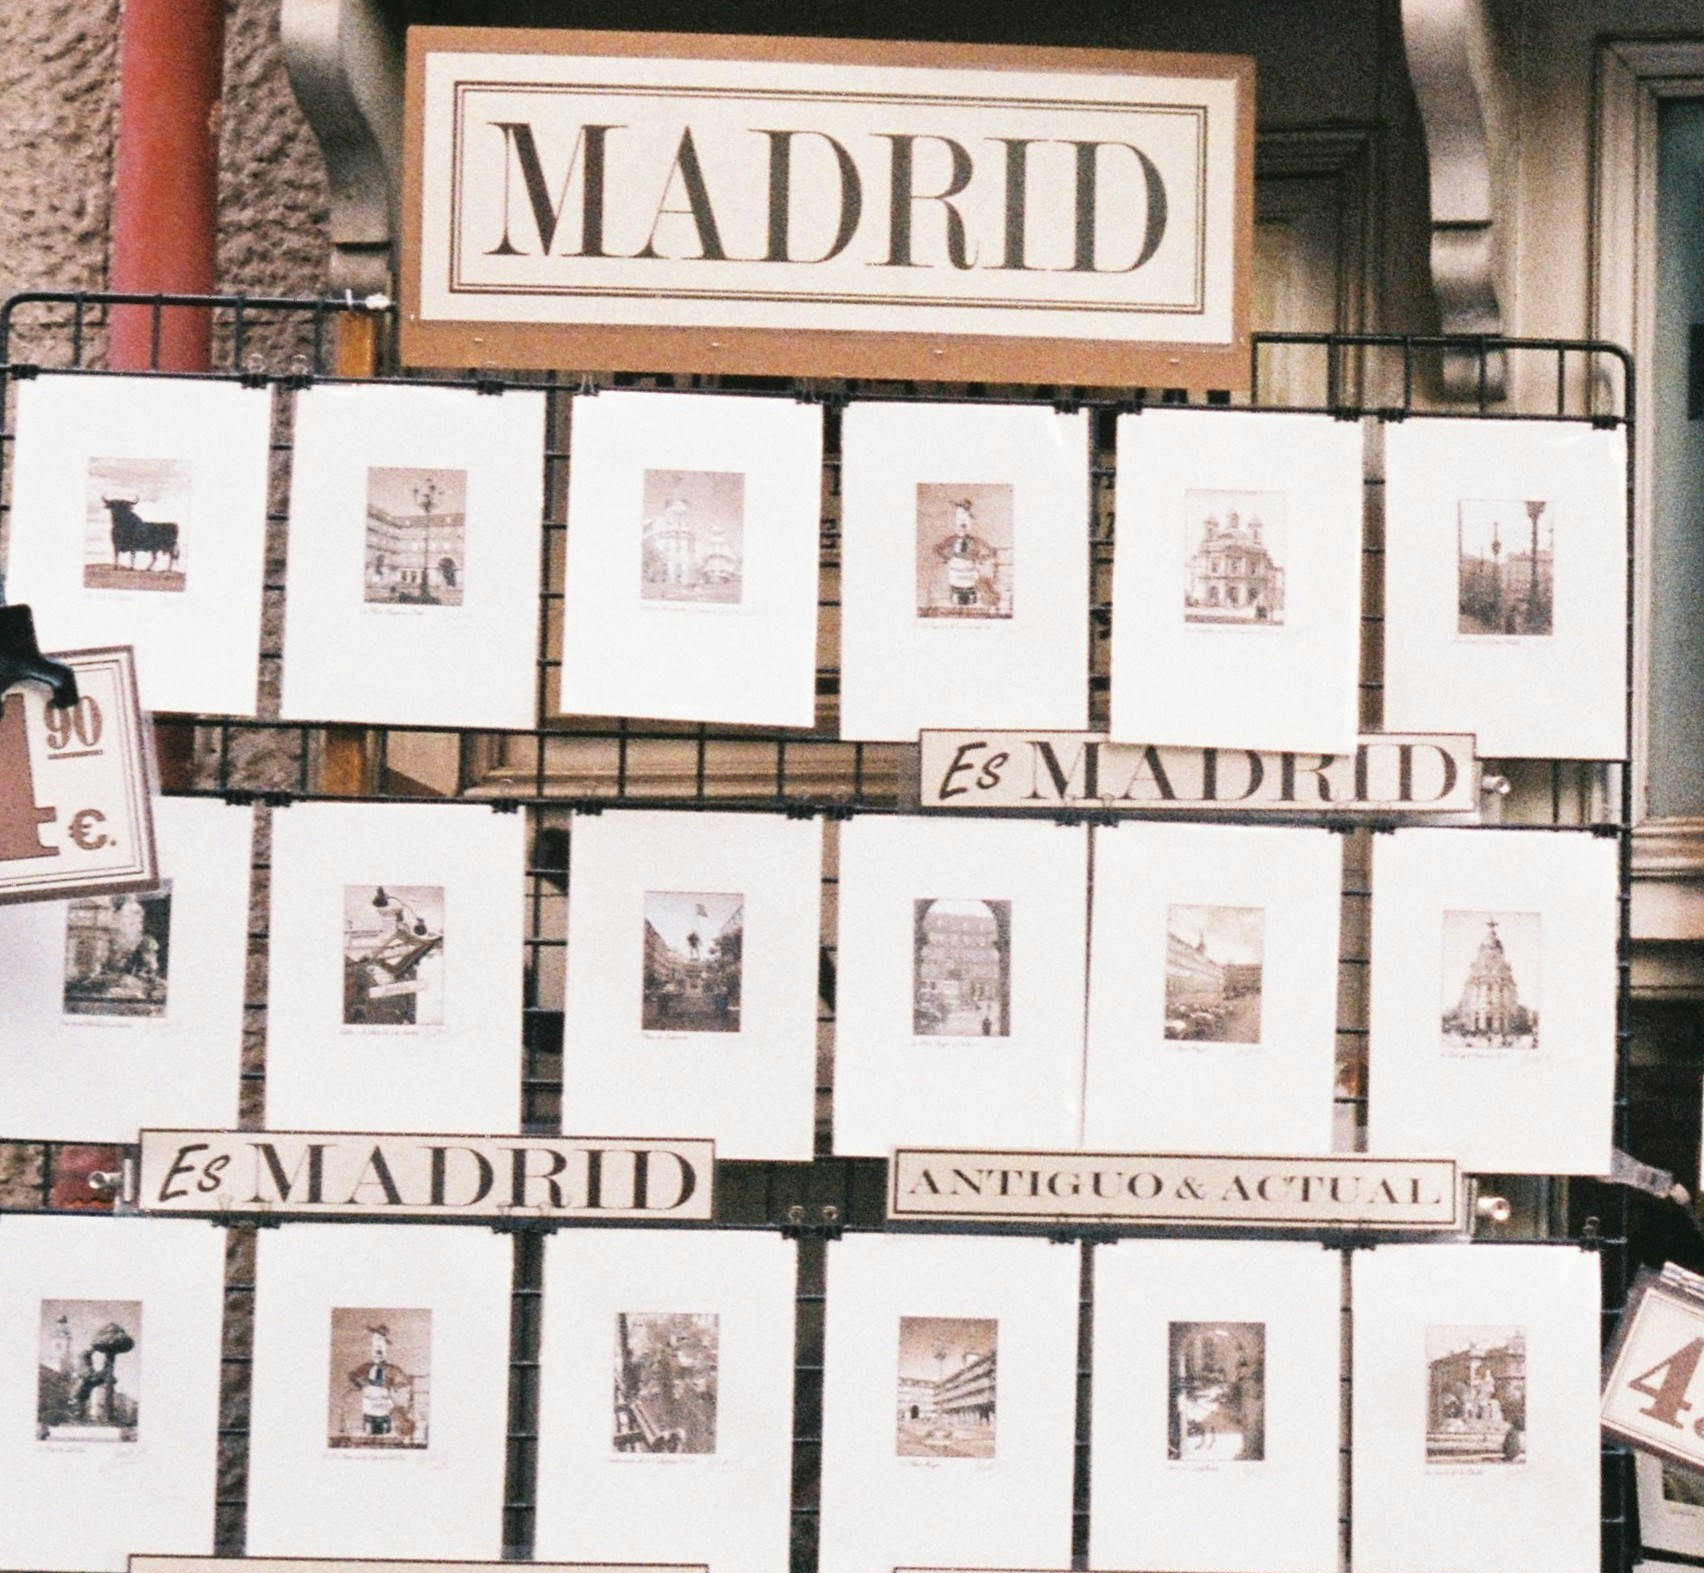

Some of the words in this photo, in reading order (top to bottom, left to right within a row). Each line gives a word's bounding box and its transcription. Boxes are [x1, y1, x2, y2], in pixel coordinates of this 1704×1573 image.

[485, 122, 1168, 274] MADRID
[44, 695, 103, 750] 90
[939, 742, 1009, 800] Es
[1020, 741, 1459, 802] MADRID
[159, 1143, 231, 1202] Es
[246, 1143, 698, 1211] MADRID
[911, 1169, 1163, 1196] ANTIGUO
[1176, 1179, 1203, 1199] &
[1222, 1176, 1440, 1204] ACTUAL
